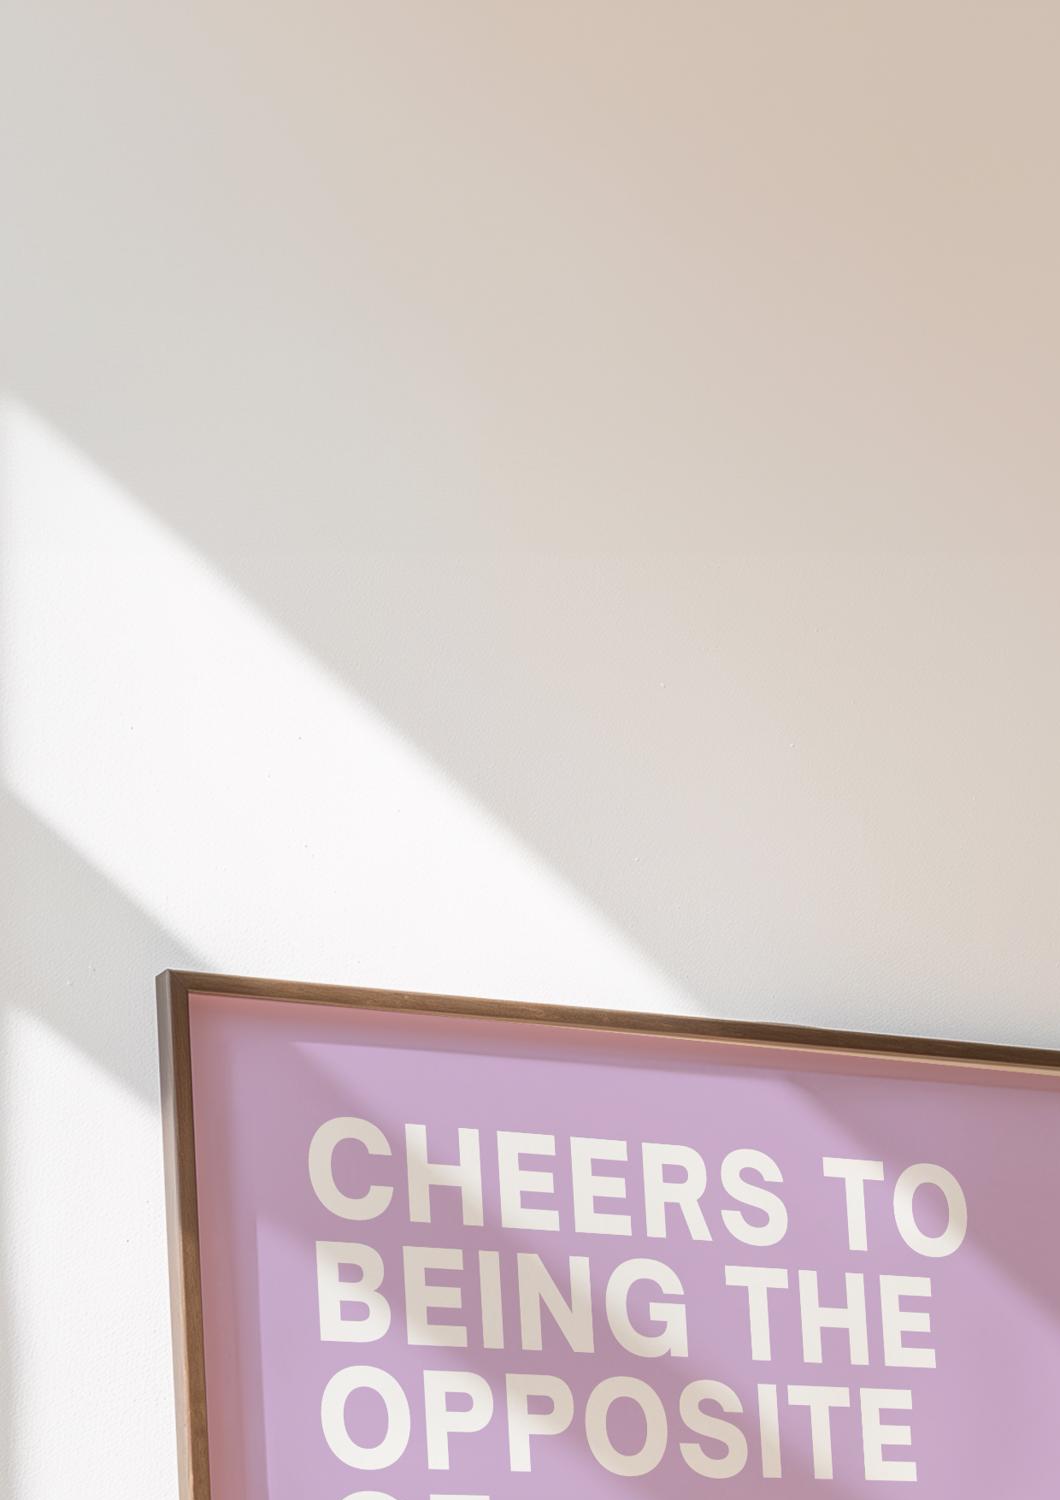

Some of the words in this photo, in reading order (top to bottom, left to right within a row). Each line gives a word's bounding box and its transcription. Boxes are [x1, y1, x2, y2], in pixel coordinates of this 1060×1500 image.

[307, 1115, 789, 1247] CHEERS
[822, 1156, 968, 1258] TO
[314, 1240, 689, 1359] BEING
[723, 1264, 937, 1369] THE
[319, 1364, 918, 1482] OPPOSITE
